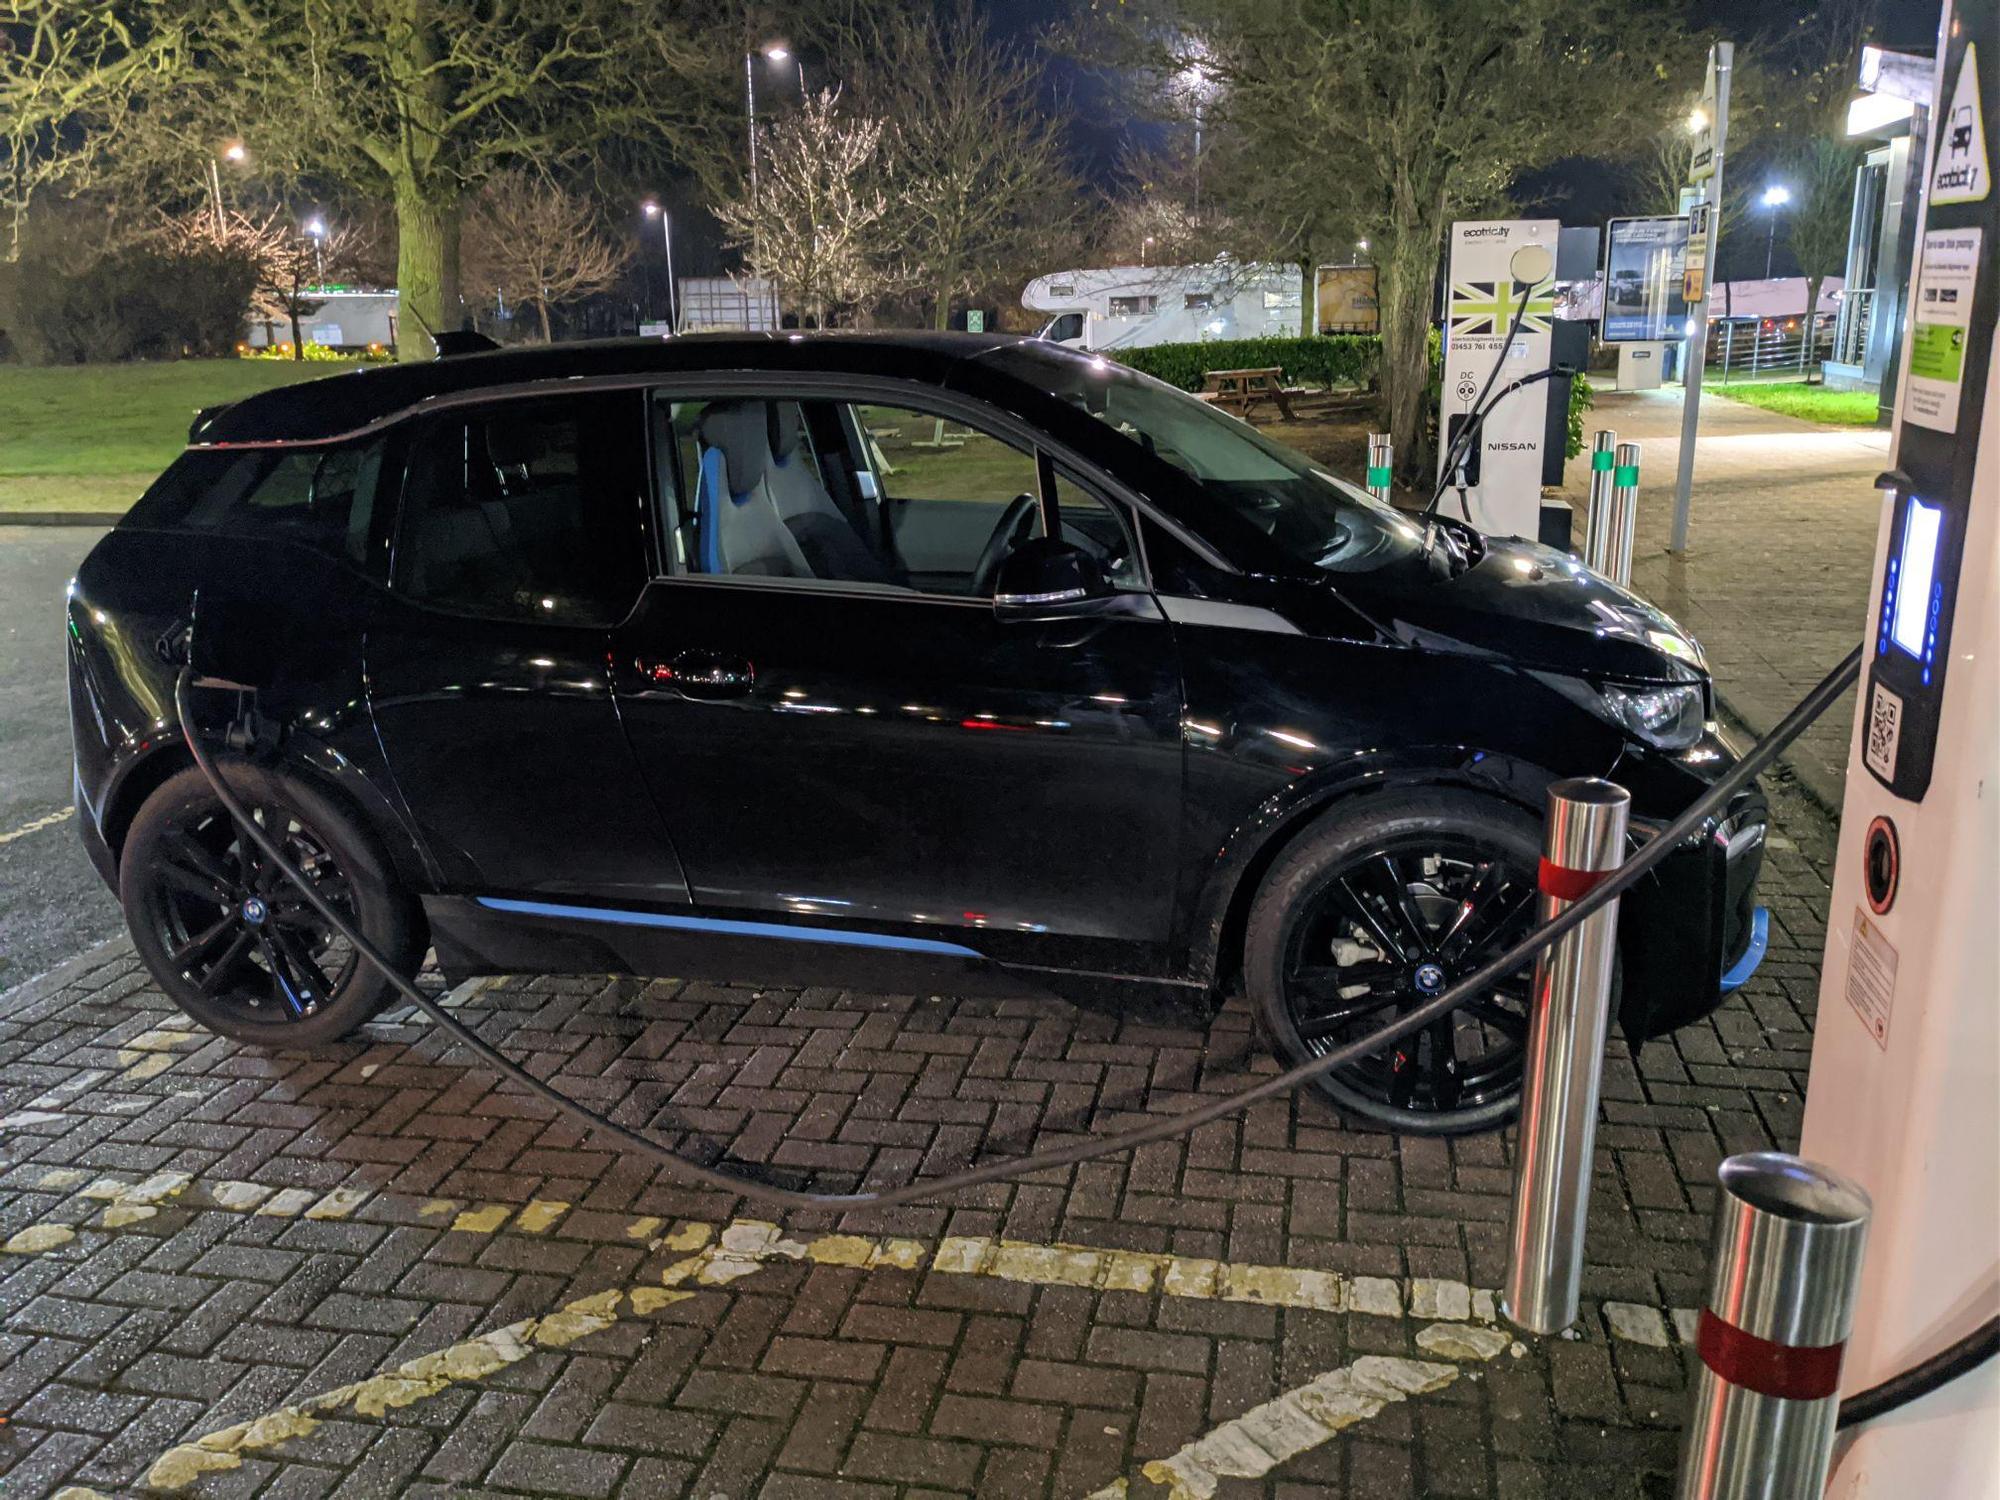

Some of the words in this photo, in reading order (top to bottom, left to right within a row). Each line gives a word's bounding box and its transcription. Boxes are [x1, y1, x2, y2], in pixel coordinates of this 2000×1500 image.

[1936, 163, 1978, 191] ecotriciy
[1463, 226, 1510, 237] ecotricity
[1460, 371, 1474, 379] DC
[1488, 442, 1537, 451] NISSAN
